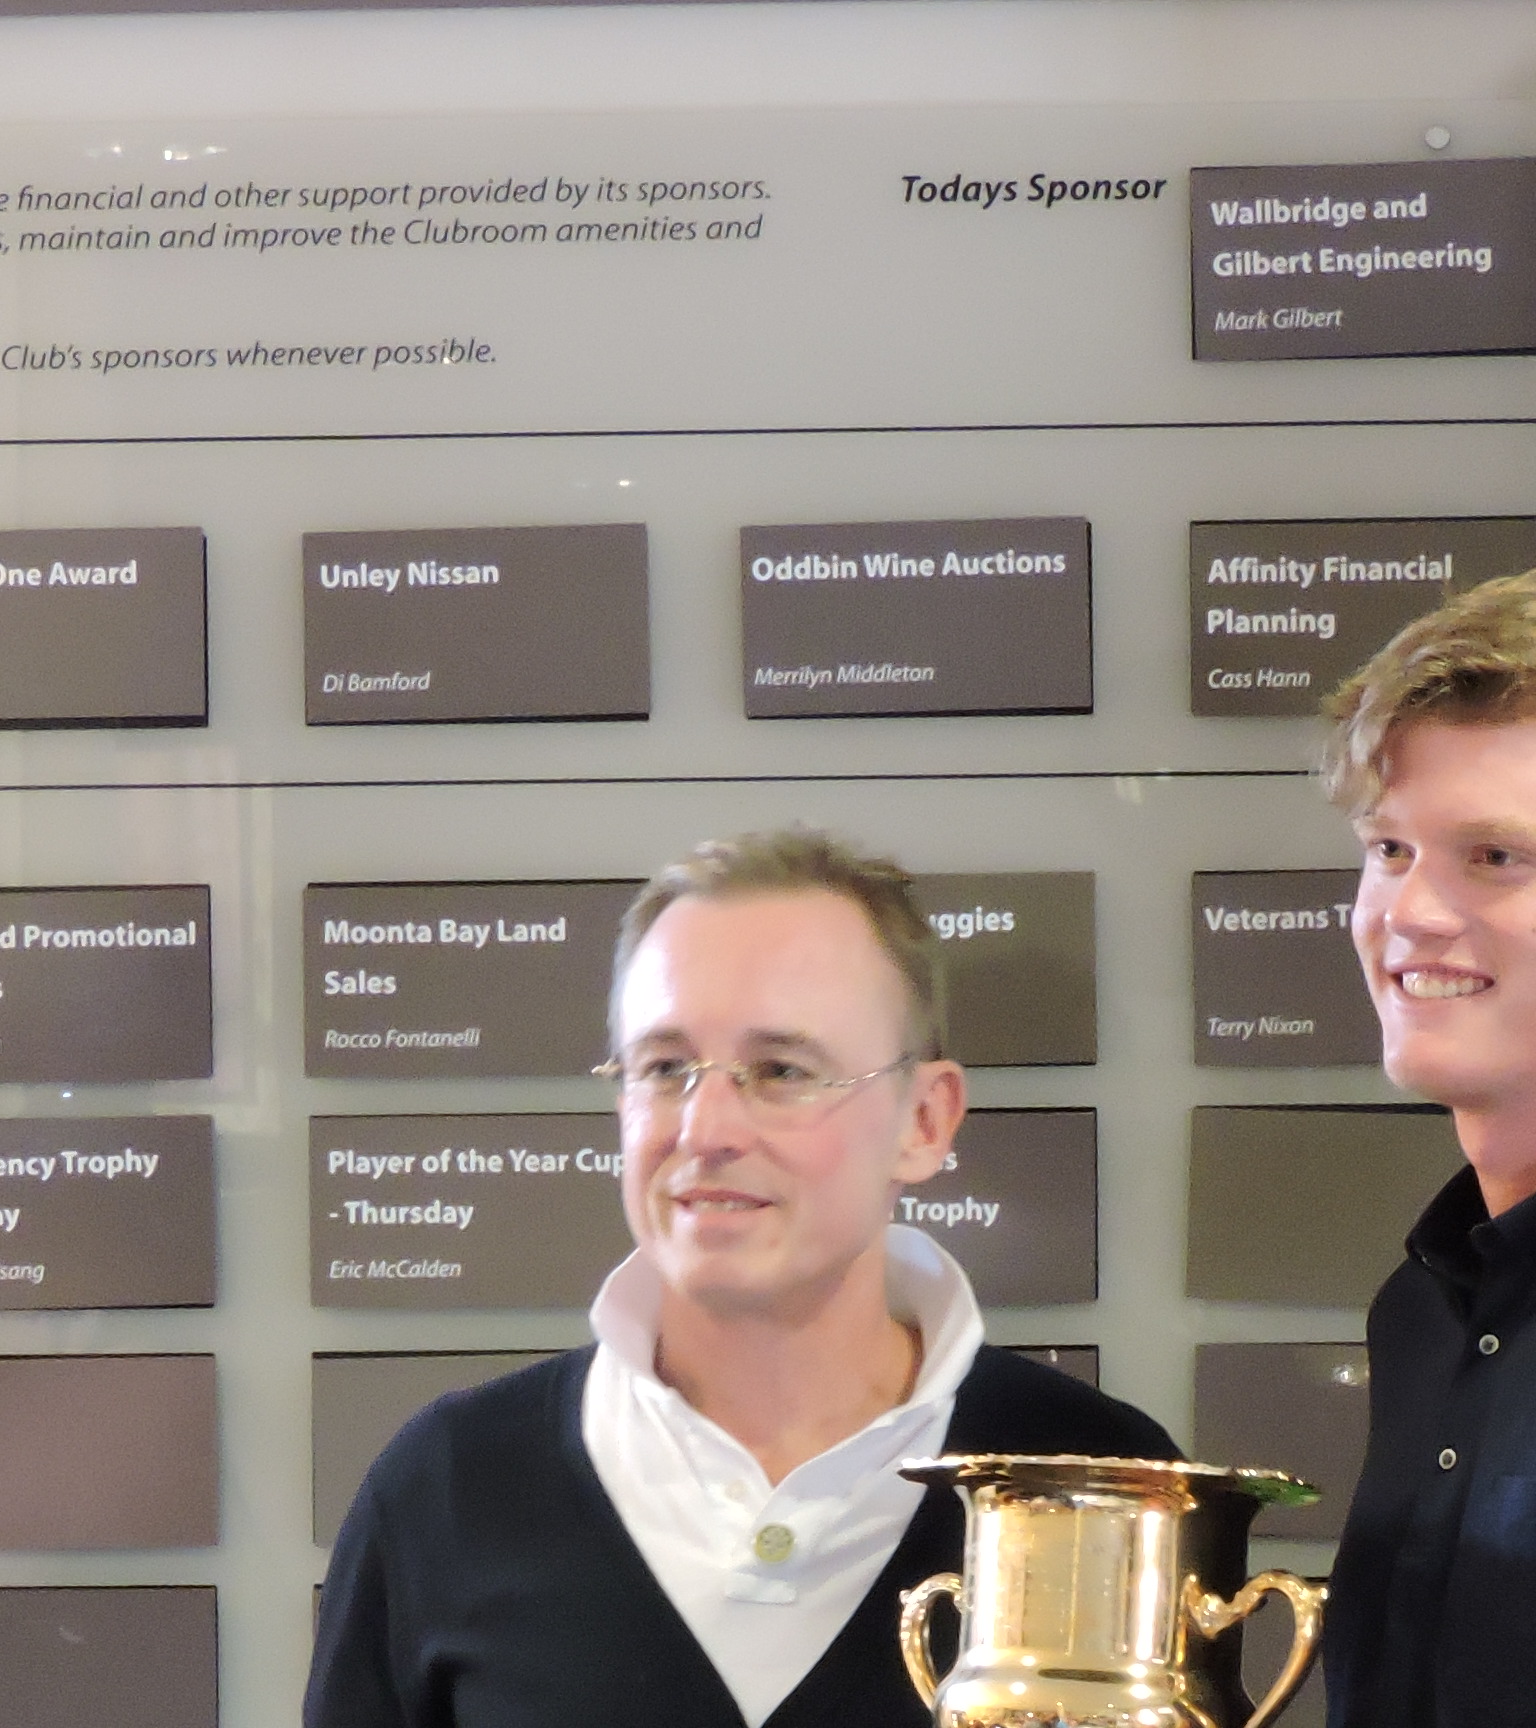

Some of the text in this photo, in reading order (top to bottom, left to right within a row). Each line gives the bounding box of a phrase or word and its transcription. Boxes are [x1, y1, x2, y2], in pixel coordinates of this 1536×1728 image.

[17, 183, 143, 212] financial
[150, 183, 208, 209] and
[214, 182, 292, 208] other
[298, 182, 411, 213] support
[417, 177, 548, 211] provided
[555, 177, 590, 210] by
[596, 176, 628, 202] its
[638, 180, 771, 207] sponsors.
[901, 173, 1167, 210] Todays Sponsor
[1210, 192, 1428, 228] Wallbridge and
[19, 224, 151, 251] maintain
[159, 222, 217, 249] and
[223, 222, 342, 254] improve
[350, 219, 396, 246] the
[404, 218, 548, 245] Clubroom
[555, 215, 697, 243] amenities
[705, 213, 764, 240] and
[1212, 242, 1492, 278] Gilbert Engineering
[1214, 307, 1343, 331] Mark Gilbert
[1, 343, 82, 371] Club's
[90, 348, 217, 375] sponsors
[226, 340, 368, 367] whenever
[372, 337, 496, 371] possible.
[48, 559, 138, 586] Award
[320, 560, 500, 593] Unley Nissan
[752, 549, 1066, 582] Oddbin Wine Auctions
[1208, 553, 1453, 589] Affinity Financial
[1207, 607, 1336, 640] Planning
[754, 662, 935, 689] Merrilyn Middleton
[1208, 668, 1311, 689] Cass Hann
[23, 920, 196, 949] Promotional
[324, 916, 566, 949] Moonta Bay Land
[1205, 907, 1329, 932] Veterans
[324, 969, 397, 995] Sales
[324, 1027, 482, 1049] Rocco Fontanelli
[1207, 1015, 1315, 1041] Terry Nixon
[60, 1147, 159, 1180] Trophy
[328, 1149, 416, 1180] Player
[421, 1147, 452, 1174] of
[456, 1148, 504, 1173] the
[508, 1148, 571, 1173] Year
[343, 1199, 474, 1231] Thursday
[906, 1196, 1000, 1228] Trophy
